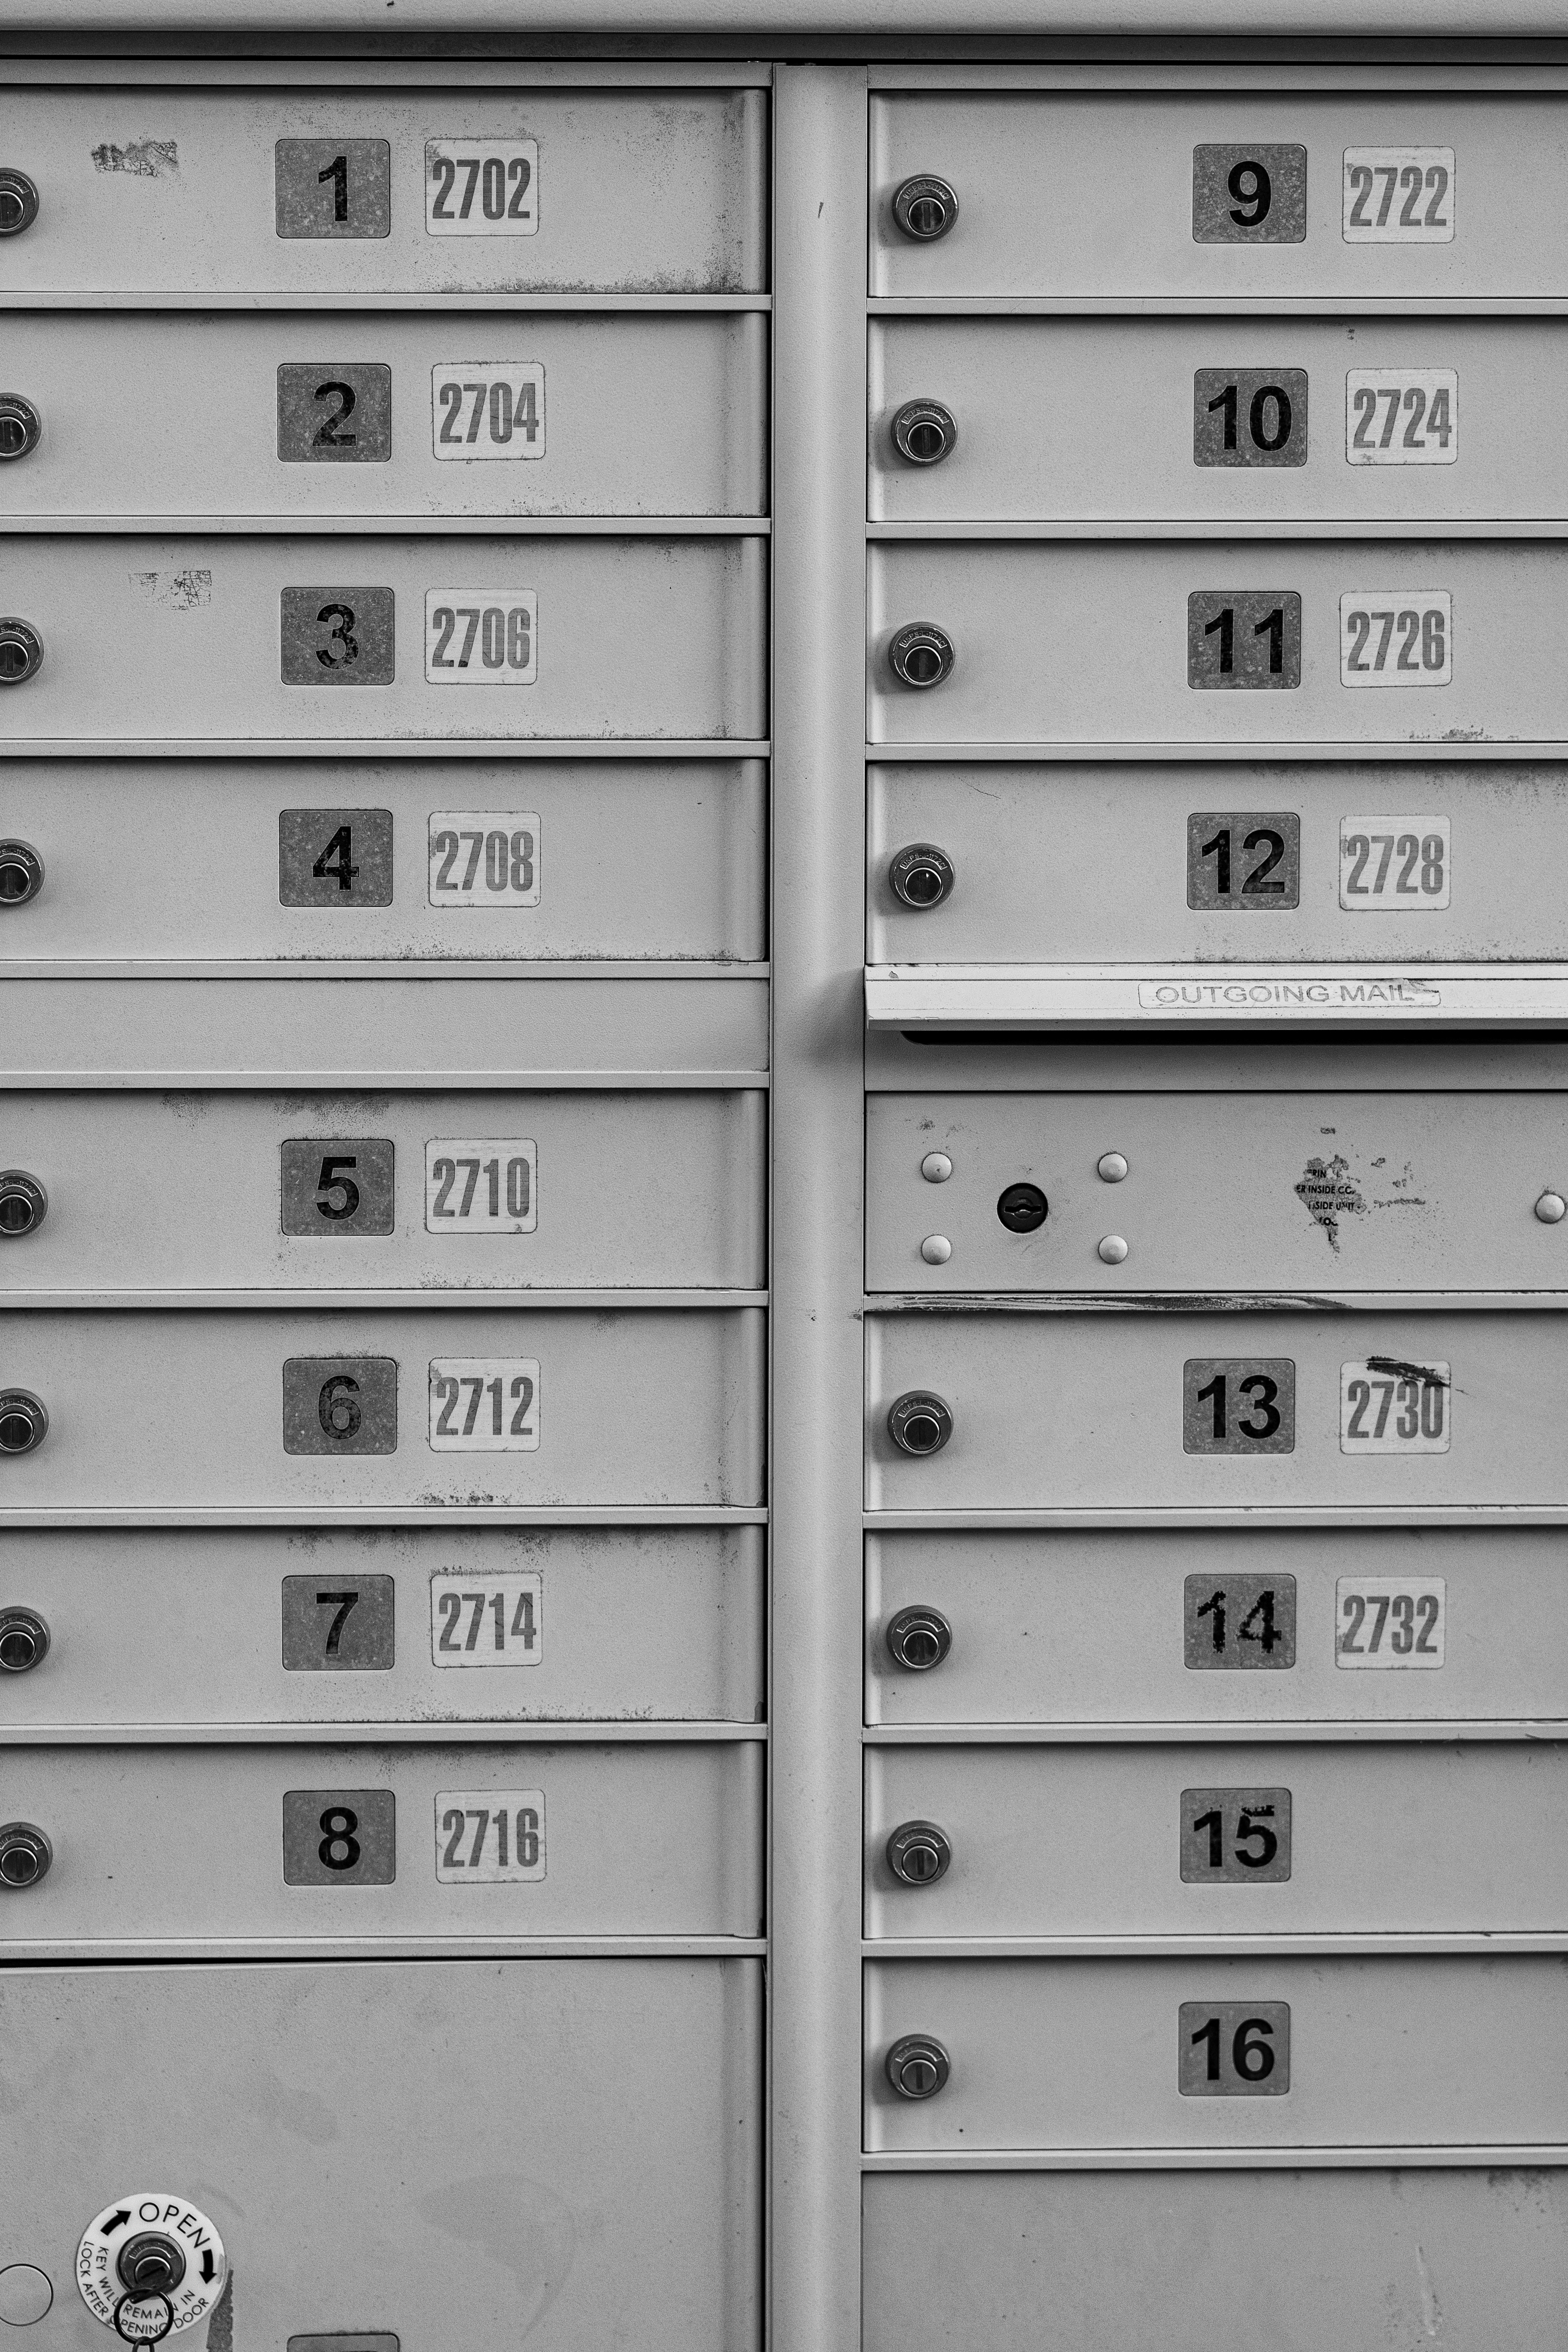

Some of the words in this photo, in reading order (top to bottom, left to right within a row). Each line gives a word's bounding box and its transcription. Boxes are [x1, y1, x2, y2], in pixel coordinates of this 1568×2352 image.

[319, 156, 348, 221] 1
[432, 158, 530, 220] 2702
[1228, 161, 1271, 226] 9
[1349, 166, 1448, 226] 2722
[313, 381, 356, 446] 2
[439, 382, 539, 444] 2704
[1209, 386, 1291, 451] 10
[1353, 388, 1451, 448] 2724
[316, 604, 359, 669] 3
[432, 607, 530, 669] 2706
[1205, 609, 1283, 673] 11
[1348, 610, 1445, 671] 2726
[313, 826, 359, 890] 4
[435, 831, 533, 891] 2708
[1202, 829, 1284, 893] 12
[1347, 834, 1444, 895] 2728
[1156, 984, 1329, 1004] OUTGOING
[1340, 984, 1415, 1002] MAIL
[317, 1157, 359, 1219] 5
[433, 1157, 530, 1218] 2710
[1308, 1185, 1335, 1193] INSIDE
[319, 1375, 361, 1440] 6
[436, 1377, 533, 1436] 2712
[1198, 1375, 1280, 1439] 13
[1348, 1380, 1443, 1438] 2730
[316, 1592, 359, 1653] 7
[439, 1592, 537, 1651] 2714
[1198, 1591, 1282, 1654] 14
[1342, 1595, 1439, 1654] 2732
[319, 1807, 361, 1870] 8
[443, 1808, 539, 1867] 2716
[1194, 1805, 1277, 1868] 15
[1192, 2019, 1275, 2081] 16
[139, 2202, 210, 2248] OPEN
[80, 2241, 94, 2277] LOCK
[96, 2246, 109, 2271] KEY
[82, 2283, 109, 2316] AFTER
[99, 2276, 119, 2307] WILL
[173, 2298, 209, 2329] DOOR
[180, 2290, 195, 2305] IN
